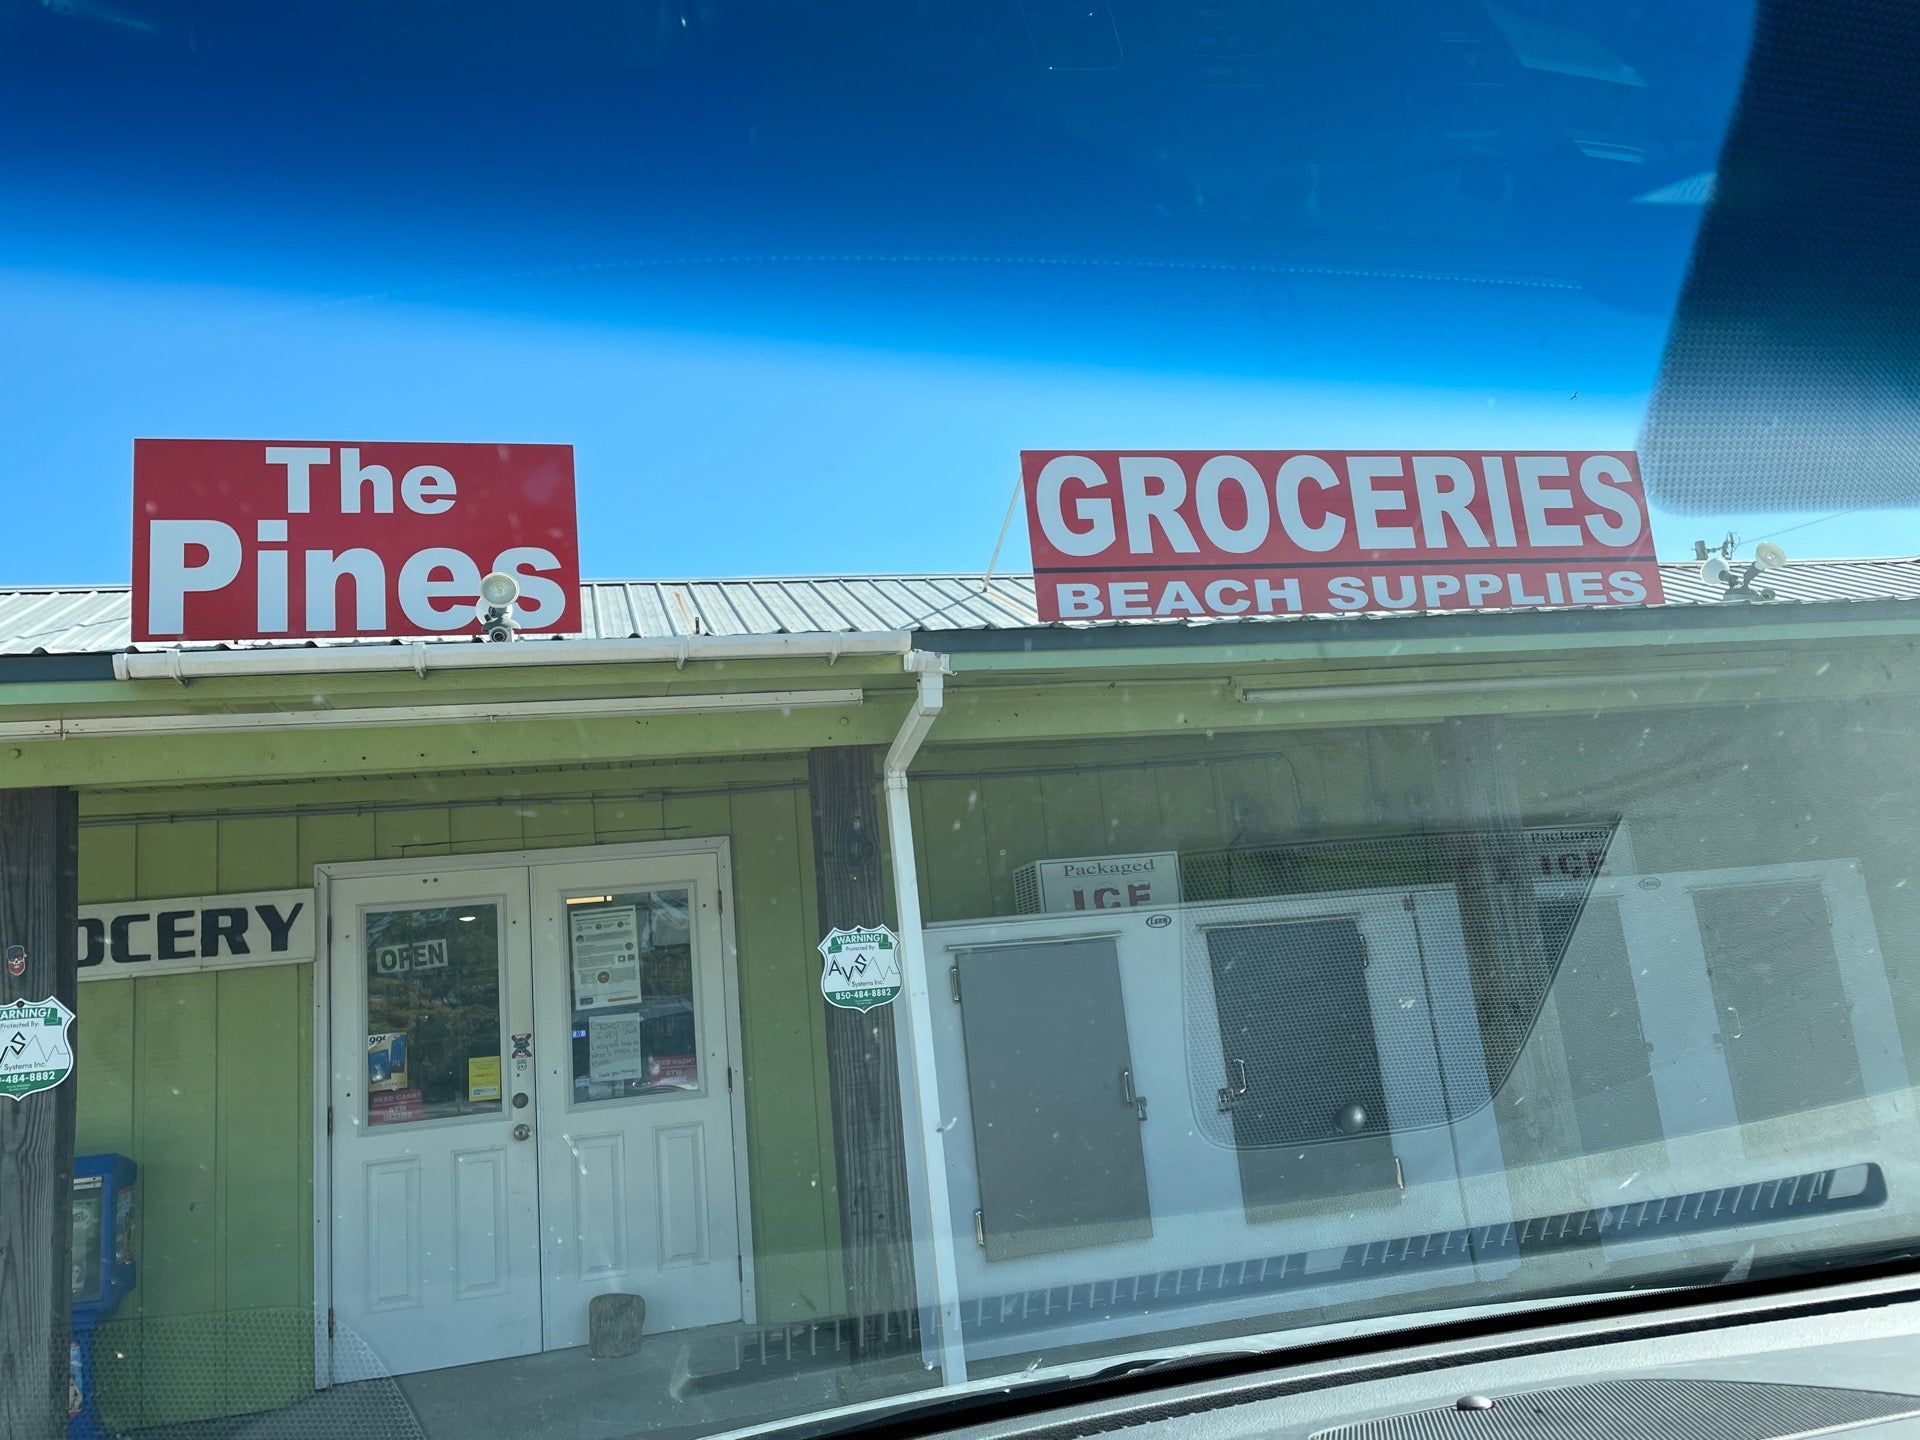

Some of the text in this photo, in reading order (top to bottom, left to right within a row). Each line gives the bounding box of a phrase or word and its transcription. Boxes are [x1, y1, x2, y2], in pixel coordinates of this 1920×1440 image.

[265, 447, 457, 514] The
[1036, 453, 1642, 557] GROCERIES
[148, 519, 566, 635] Pines
[1056, 570, 1647, 618] BEACH SUPPLIES
[1064, 859, 1155, 876] Packaged
[836, 934, 884, 944] WARNING!
[381, 942, 444, 970] OPEN
[828, 953, 867, 982] AVS
[835, 988, 892, 1000] 850-484-8882
[0, 1008, 51, 1020] ARNING!
[1, 1021, 29, 1029] Protected
[4, 1062, 32, 1071] Systems
[0, 1071, 55, 1085] -484-8882
